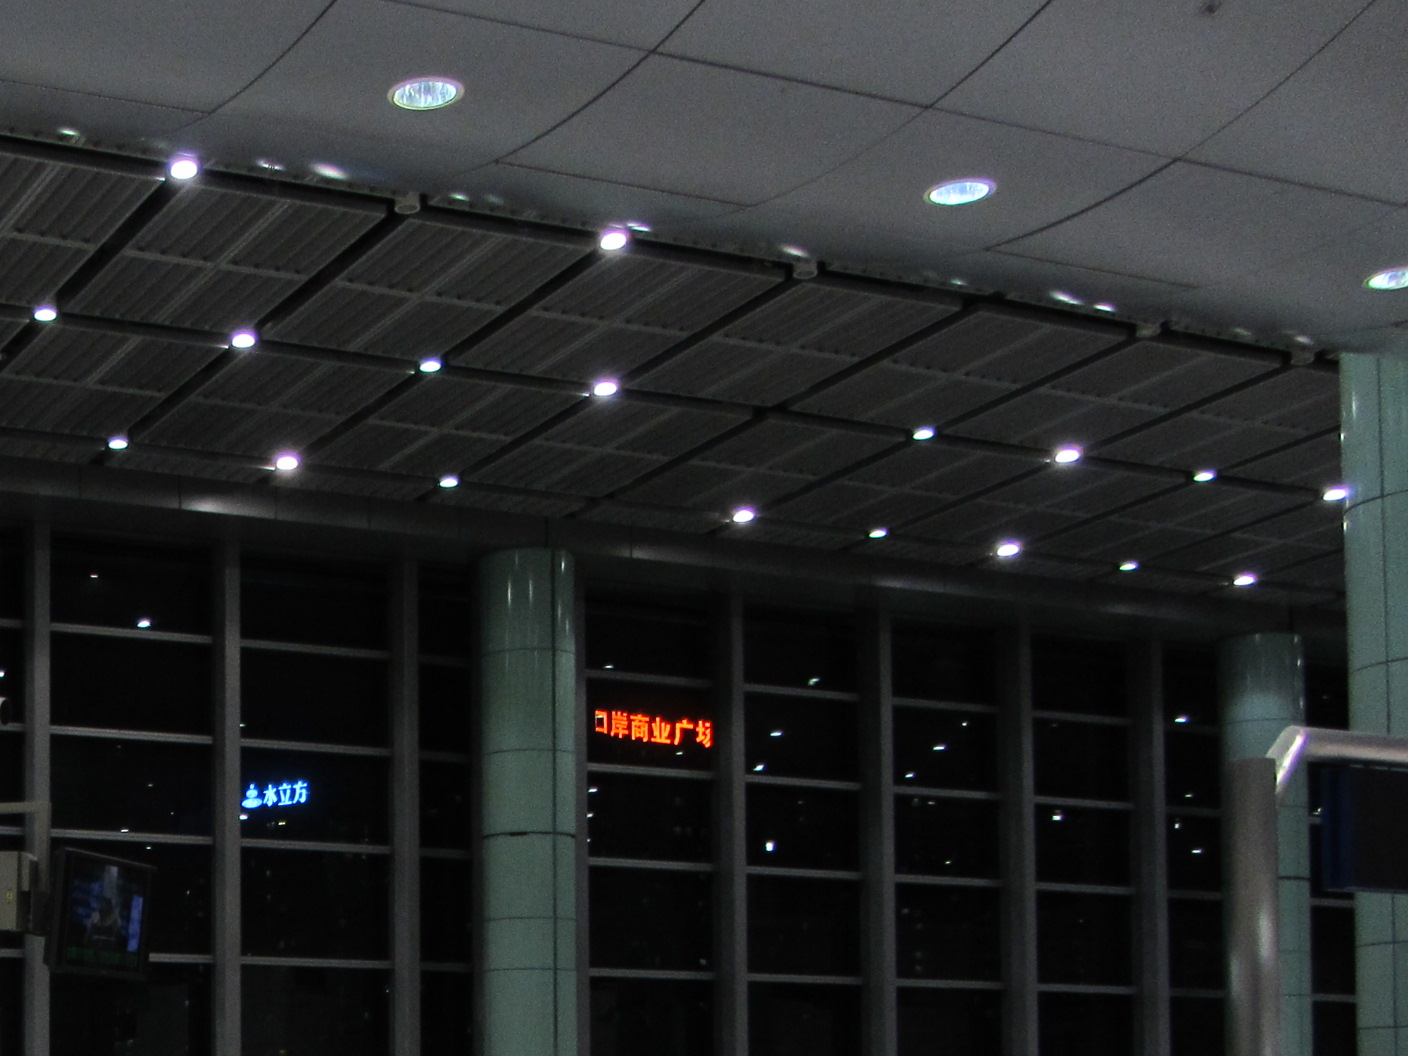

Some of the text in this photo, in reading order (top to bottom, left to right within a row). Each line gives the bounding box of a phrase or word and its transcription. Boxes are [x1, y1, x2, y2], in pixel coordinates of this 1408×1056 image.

[594, 709, 712, 748] 口岸商业广场
[262, 780, 308, 807] 水立方
